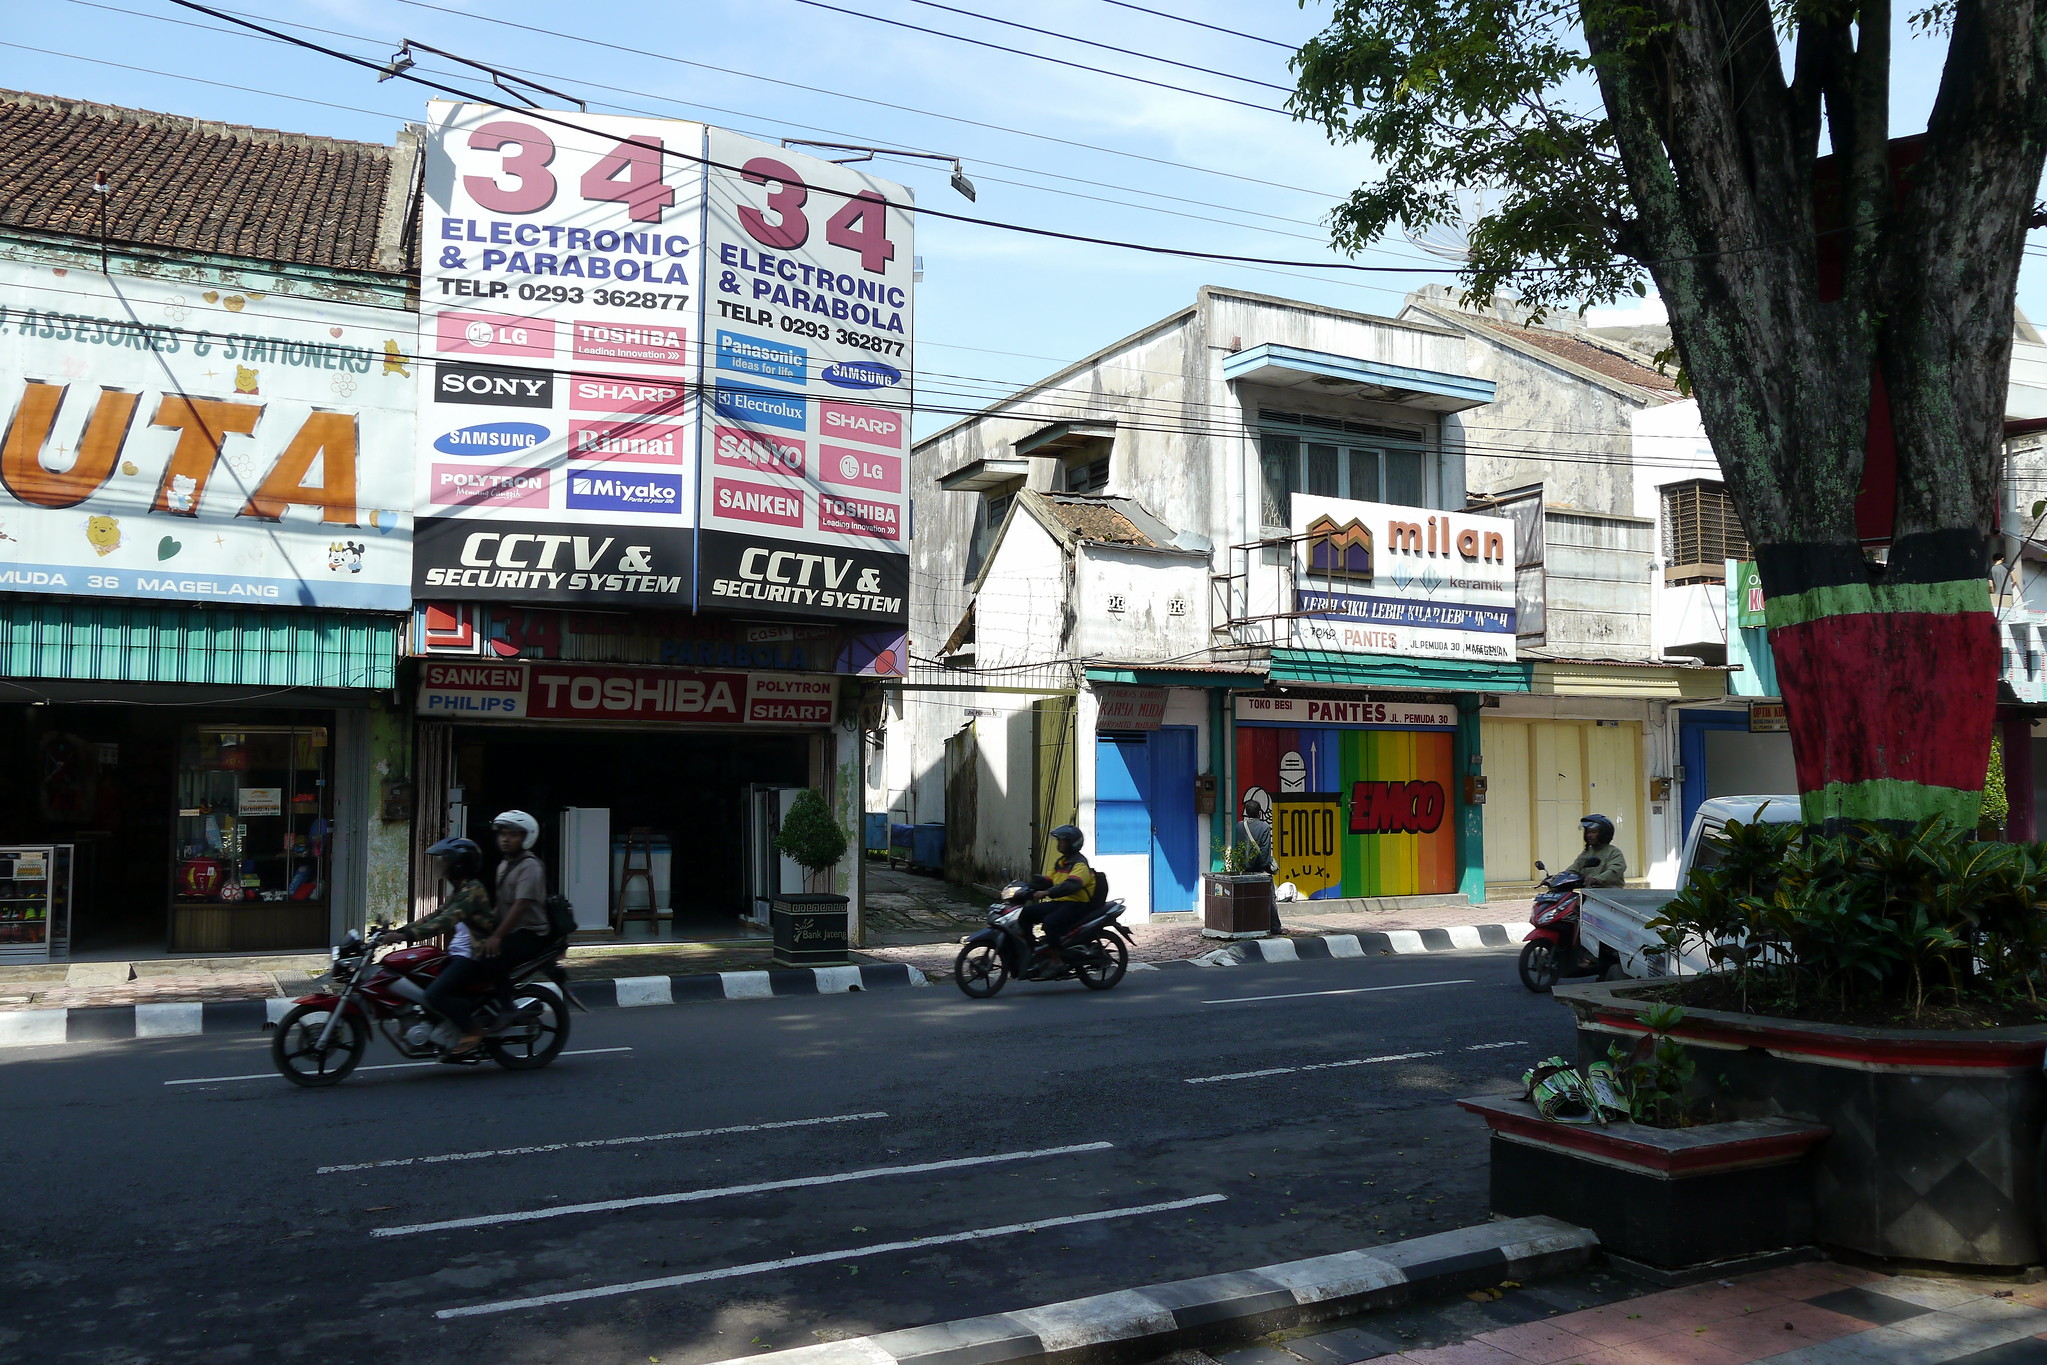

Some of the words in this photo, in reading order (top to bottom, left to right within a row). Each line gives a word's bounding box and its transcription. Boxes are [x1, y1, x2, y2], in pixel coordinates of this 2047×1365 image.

[441, 217, 690, 258] ELECTRONIC
[439, 246, 468, 269] &
[483, 249, 690, 286] PARABOLA
[720, 242, 905, 308] ELECTRONIC
[437, 277, 509, 299] TELP.
[518, 283, 584, 304] 0293
[593, 289, 690, 311] 362877
[718, 270, 742, 296] &
[752, 277, 905, 335] PARABOLA
[19, 307, 180, 355] ASSESORIES
[193, 331, 211, 357] &
[223, 333, 374, 374] STATIONERY
[500, 328, 528, 346] LG
[578, 325, 681, 348] TOSHIBA
[717, 299, 774, 328] TELP.
[780, 315, 830, 341] 0293
[836, 328, 905, 358] 362877
[578, 346, 616, 357] Leading
[617, 348, 666, 360] Innovation
[722, 335, 803, 366] Panasonic
[732, 358, 761, 373] ideas
[762, 361, 777, 375] for
[777, 362, 794, 378] life
[832, 363, 893, 388] SAMSUNG
[442, 374, 546, 397] SONY
[578, 384, 677, 402] SHARP
[734, 393, 803, 420] Electrolux
[825, 410, 897, 435] SHARP
[449, 430, 536, 448] SAMSUNG
[576, 429, 675, 456] Rinnai
[0, 378, 362, 530] UTA
[718, 435, 802, 470] SANYO
[440, 473, 542, 489] POLYTRON
[863, 461, 884, 480] LG
[456, 486, 489, 499] Memang
[593, 479, 676, 501] Miyako
[719, 488, 799, 518] SANKEN
[823, 498, 896, 523] TOSHIBA
[822, 517, 850, 530] Leading
[851, 521, 886, 534] Innovation
[1388, 516, 1504, 561] milan
[460, 532, 615, 571] CCTV
[618, 546, 652, 573] &
[425, 568, 567, 589] SECURITY
[568, 573, 682, 593] SYSTEM
[738, 547, 854, 590] CCTV
[856, 568, 882, 594] &
[87, 575, 119, 589] 36
[137, 578, 280, 598] MAGELANG
[711, 579, 822, 605] SECURITY
[821, 591, 901, 614] SYSTEM
[1450, 575, 1503, 593] keramik
[491, 606, 562, 657] 34
[751, 626, 789, 641] cash
[1344, 629, 1397, 649] PANTES
[1450, 642, 1460, 651] 30
[660, 640, 809, 671] PARABOLA
[430, 667, 520, 687] SANKEN
[756, 680, 830, 694] POLYTRON
[428, 695, 516, 712] PHILIPS
[538, 675, 736, 714] TOSHIBA
[753, 704, 829, 719] SHARP
[1138, 703, 1165, 717] MUDA
[1249, 699, 1271, 709] TOKO
[1274, 700, 1293, 710] BESI
[1308, 701, 1387, 722] PANTES
[1389, 713, 1402, 723] JL.
[1404, 714, 1435, 724] PEMUDA
[1438, 715, 1449, 724] 30
[1349, 780, 1446, 835] EMCO
[1280, 809, 1334, 857] EMCO
[803, 930, 822, 939] Bank
[823, 929, 847, 941] Jateng
